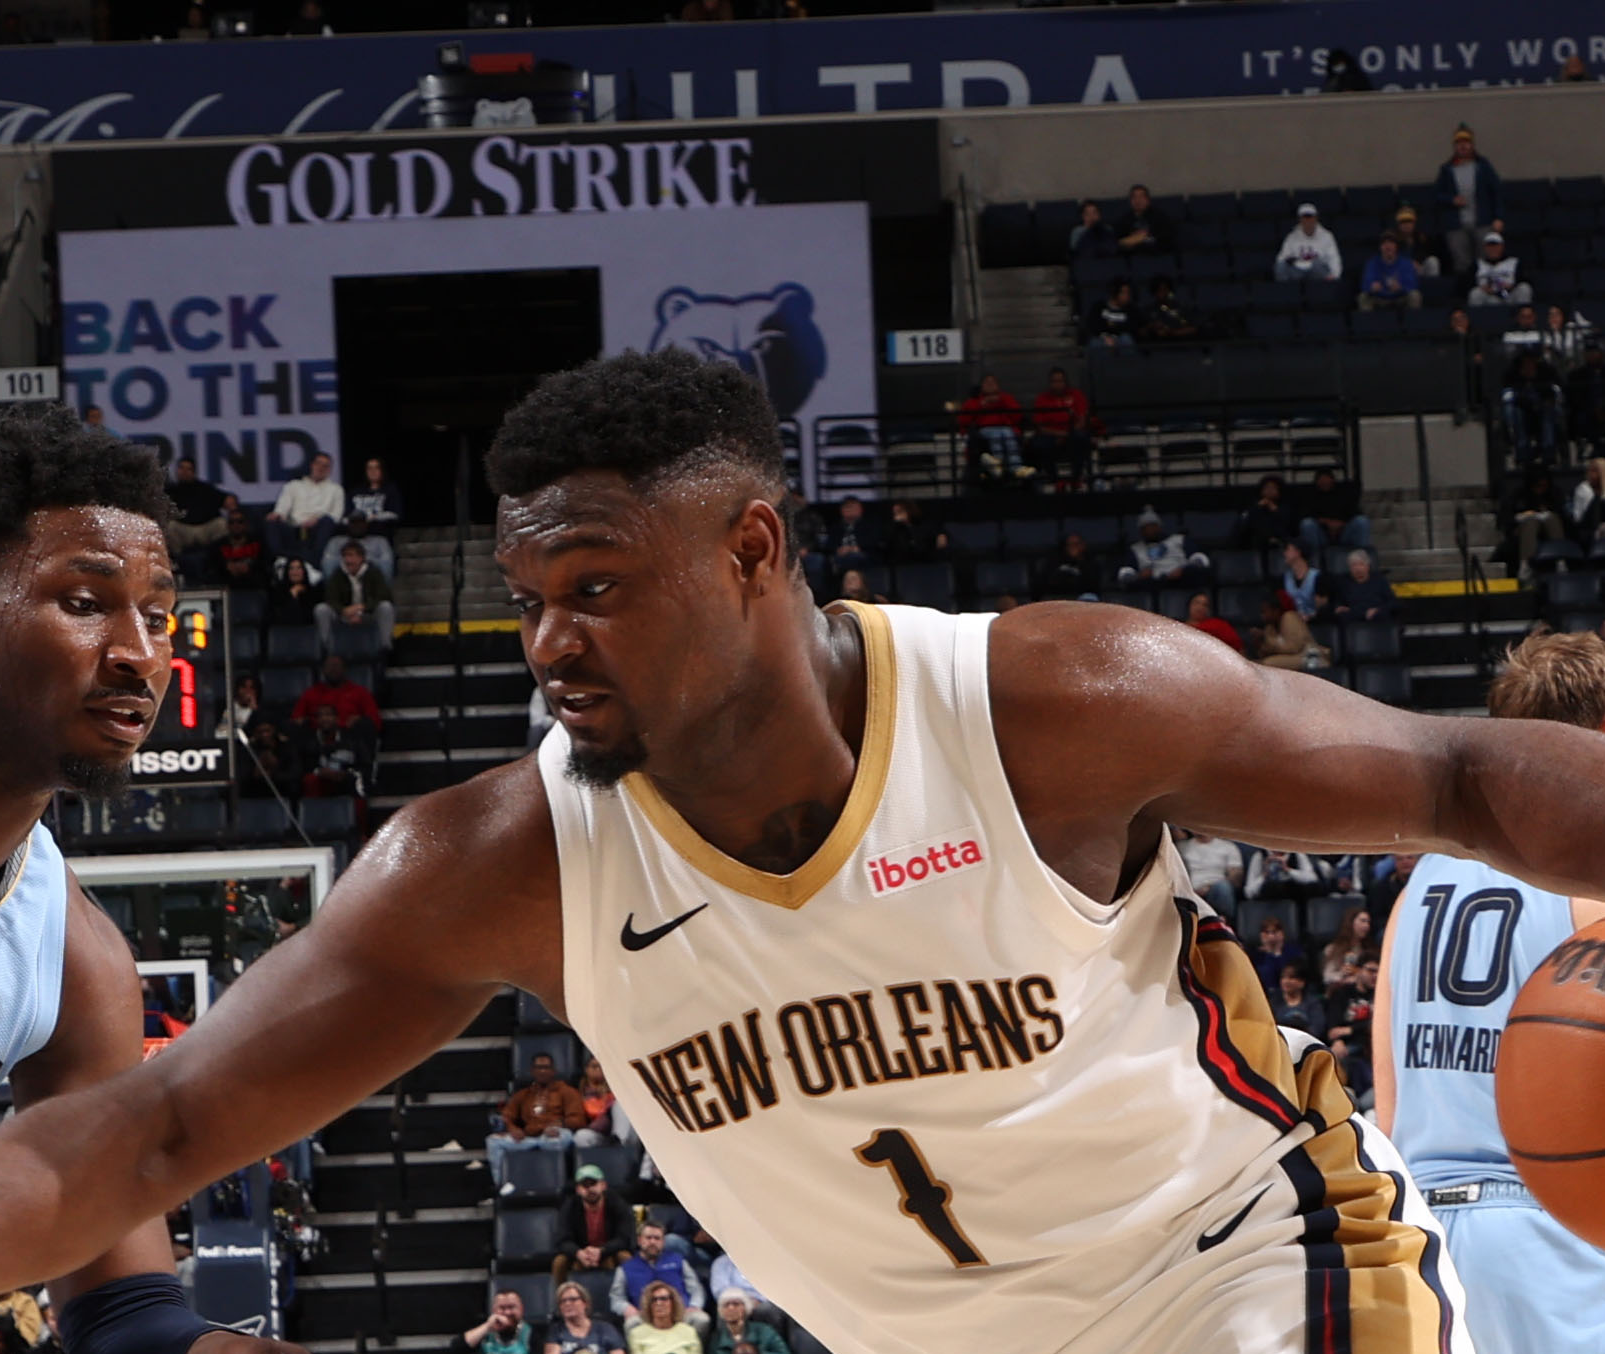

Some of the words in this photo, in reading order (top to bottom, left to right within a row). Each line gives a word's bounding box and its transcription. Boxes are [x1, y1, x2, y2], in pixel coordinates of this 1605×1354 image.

[1360, 42, 1481, 74] ONLY
[225, 142, 454, 226] GOLD
[470, 135, 757, 216] STRIKE
[61, 293, 281, 356] BACK
[907, 333, 950, 358] 118
[5, 372, 46, 396] 101
[62, 365, 170, 424] TO
[187, 358, 339, 418] THE
[130, 748, 224, 775] ISSOT
[868, 838, 984, 893] ibotta
[1416, 883, 1524, 1007] 10
[628, 1006, 781, 1134] NEW
[776, 973, 1065, 1098] ORLEANS
[850, 1127, 990, 1269] 1
